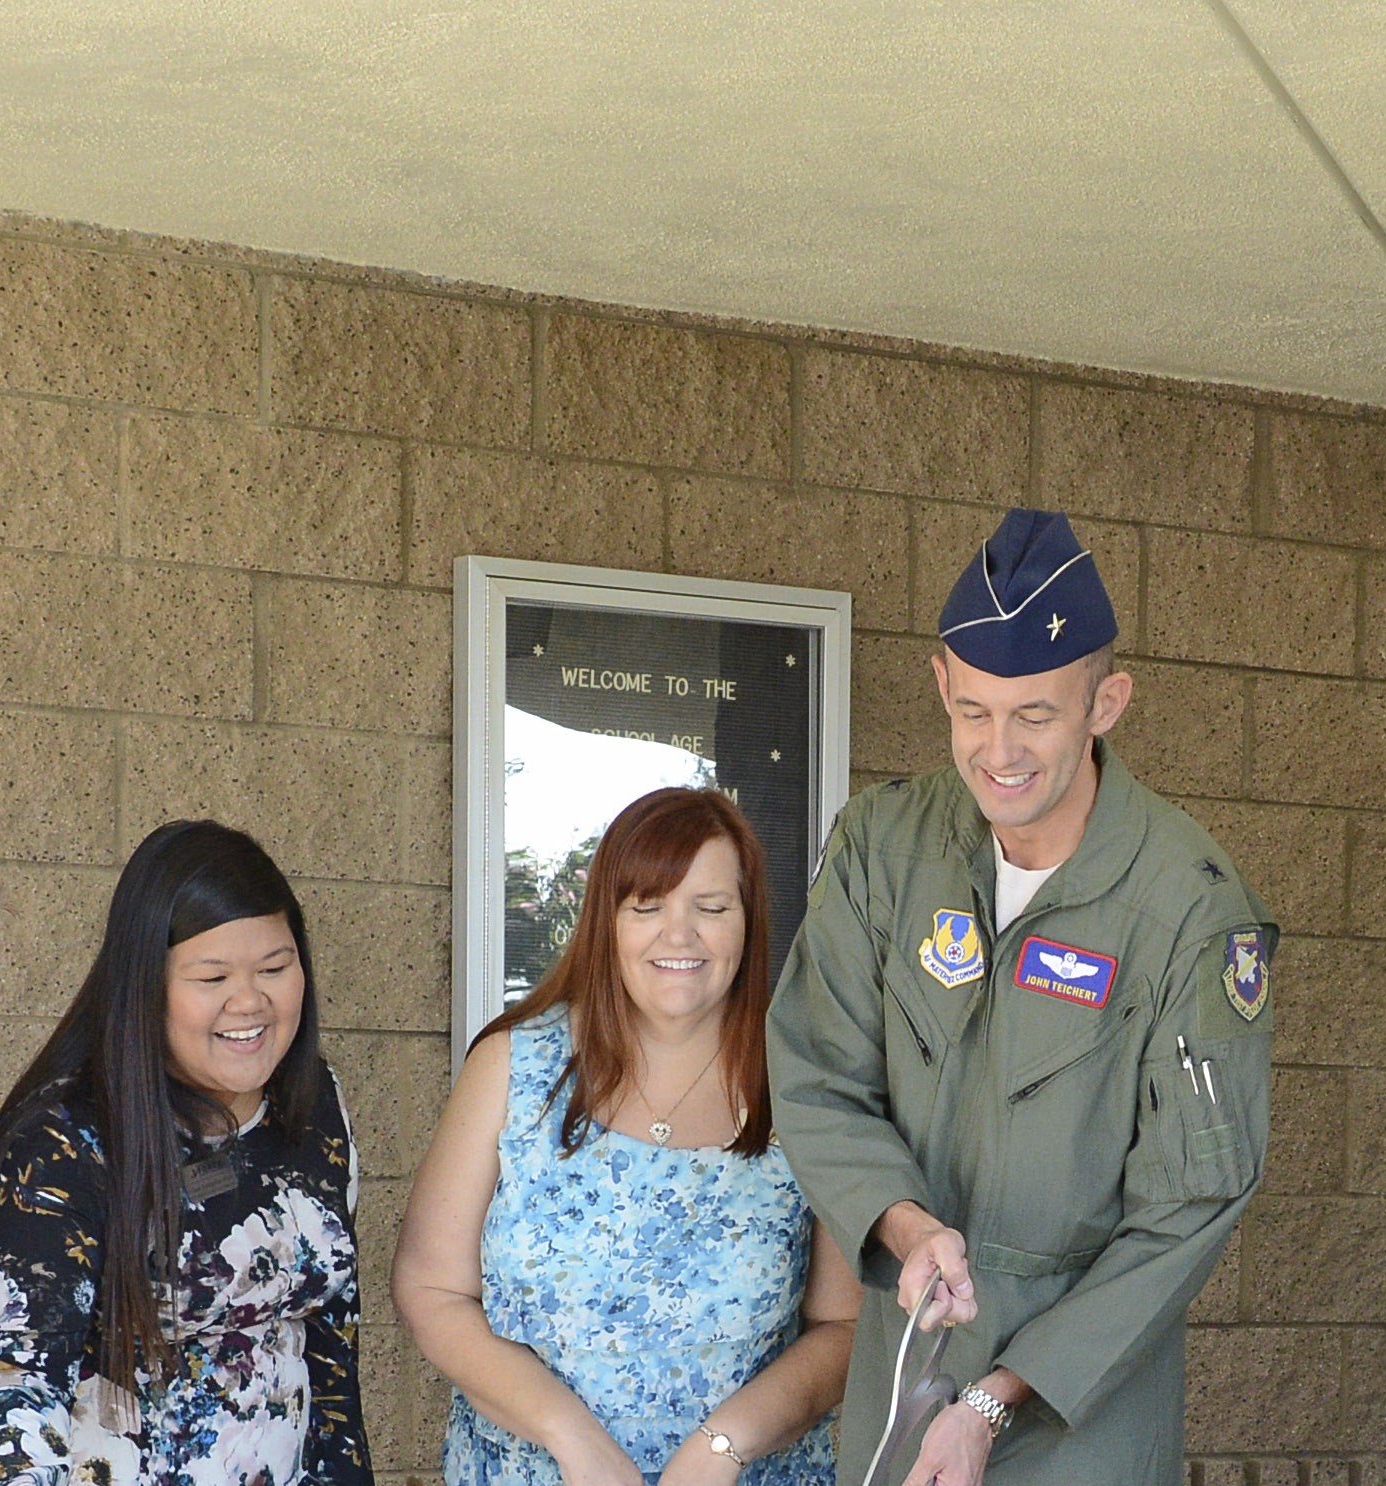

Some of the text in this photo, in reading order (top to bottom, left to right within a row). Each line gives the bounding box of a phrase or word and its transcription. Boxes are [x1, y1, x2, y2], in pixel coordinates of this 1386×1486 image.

[561, 666, 738, 701] WELCOME TO THE
[1025, 973, 1098, 1002] JOHN TEICHERT
